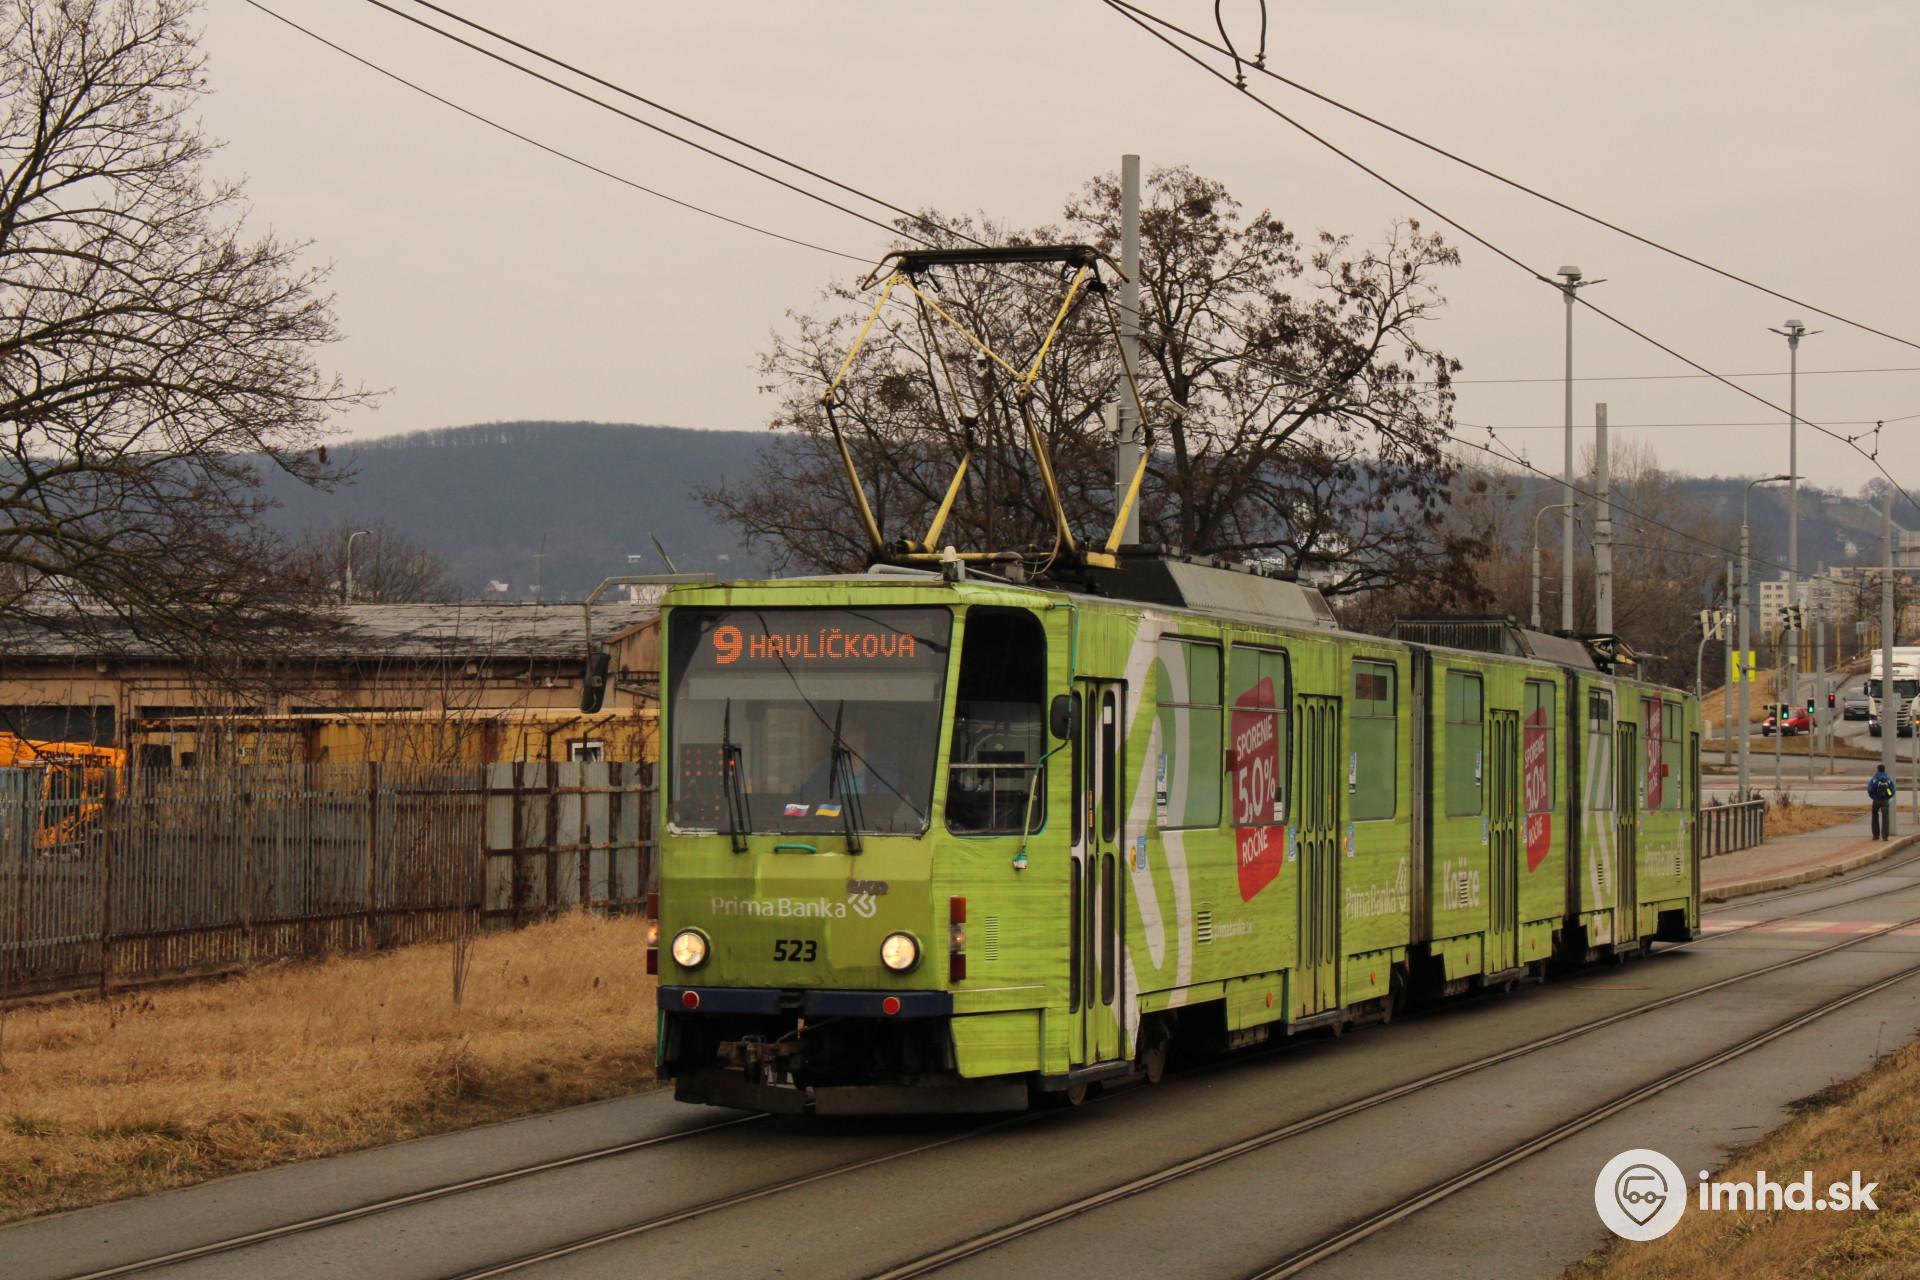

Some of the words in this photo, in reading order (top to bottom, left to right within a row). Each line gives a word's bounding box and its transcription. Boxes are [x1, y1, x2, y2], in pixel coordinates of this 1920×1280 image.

[713, 625, 743, 664] 9
[750, 628, 915, 658] HAVLÍČKOVA
[1236, 714, 1273, 762] SPORENIE
[1239, 756, 1276, 824] 5,0%
[1242, 826, 1269, 867] ROČNE
[711, 896, 774, 917] Prima
[778, 897, 846, 918] Banka
[773, 939, 818, 962] 523
